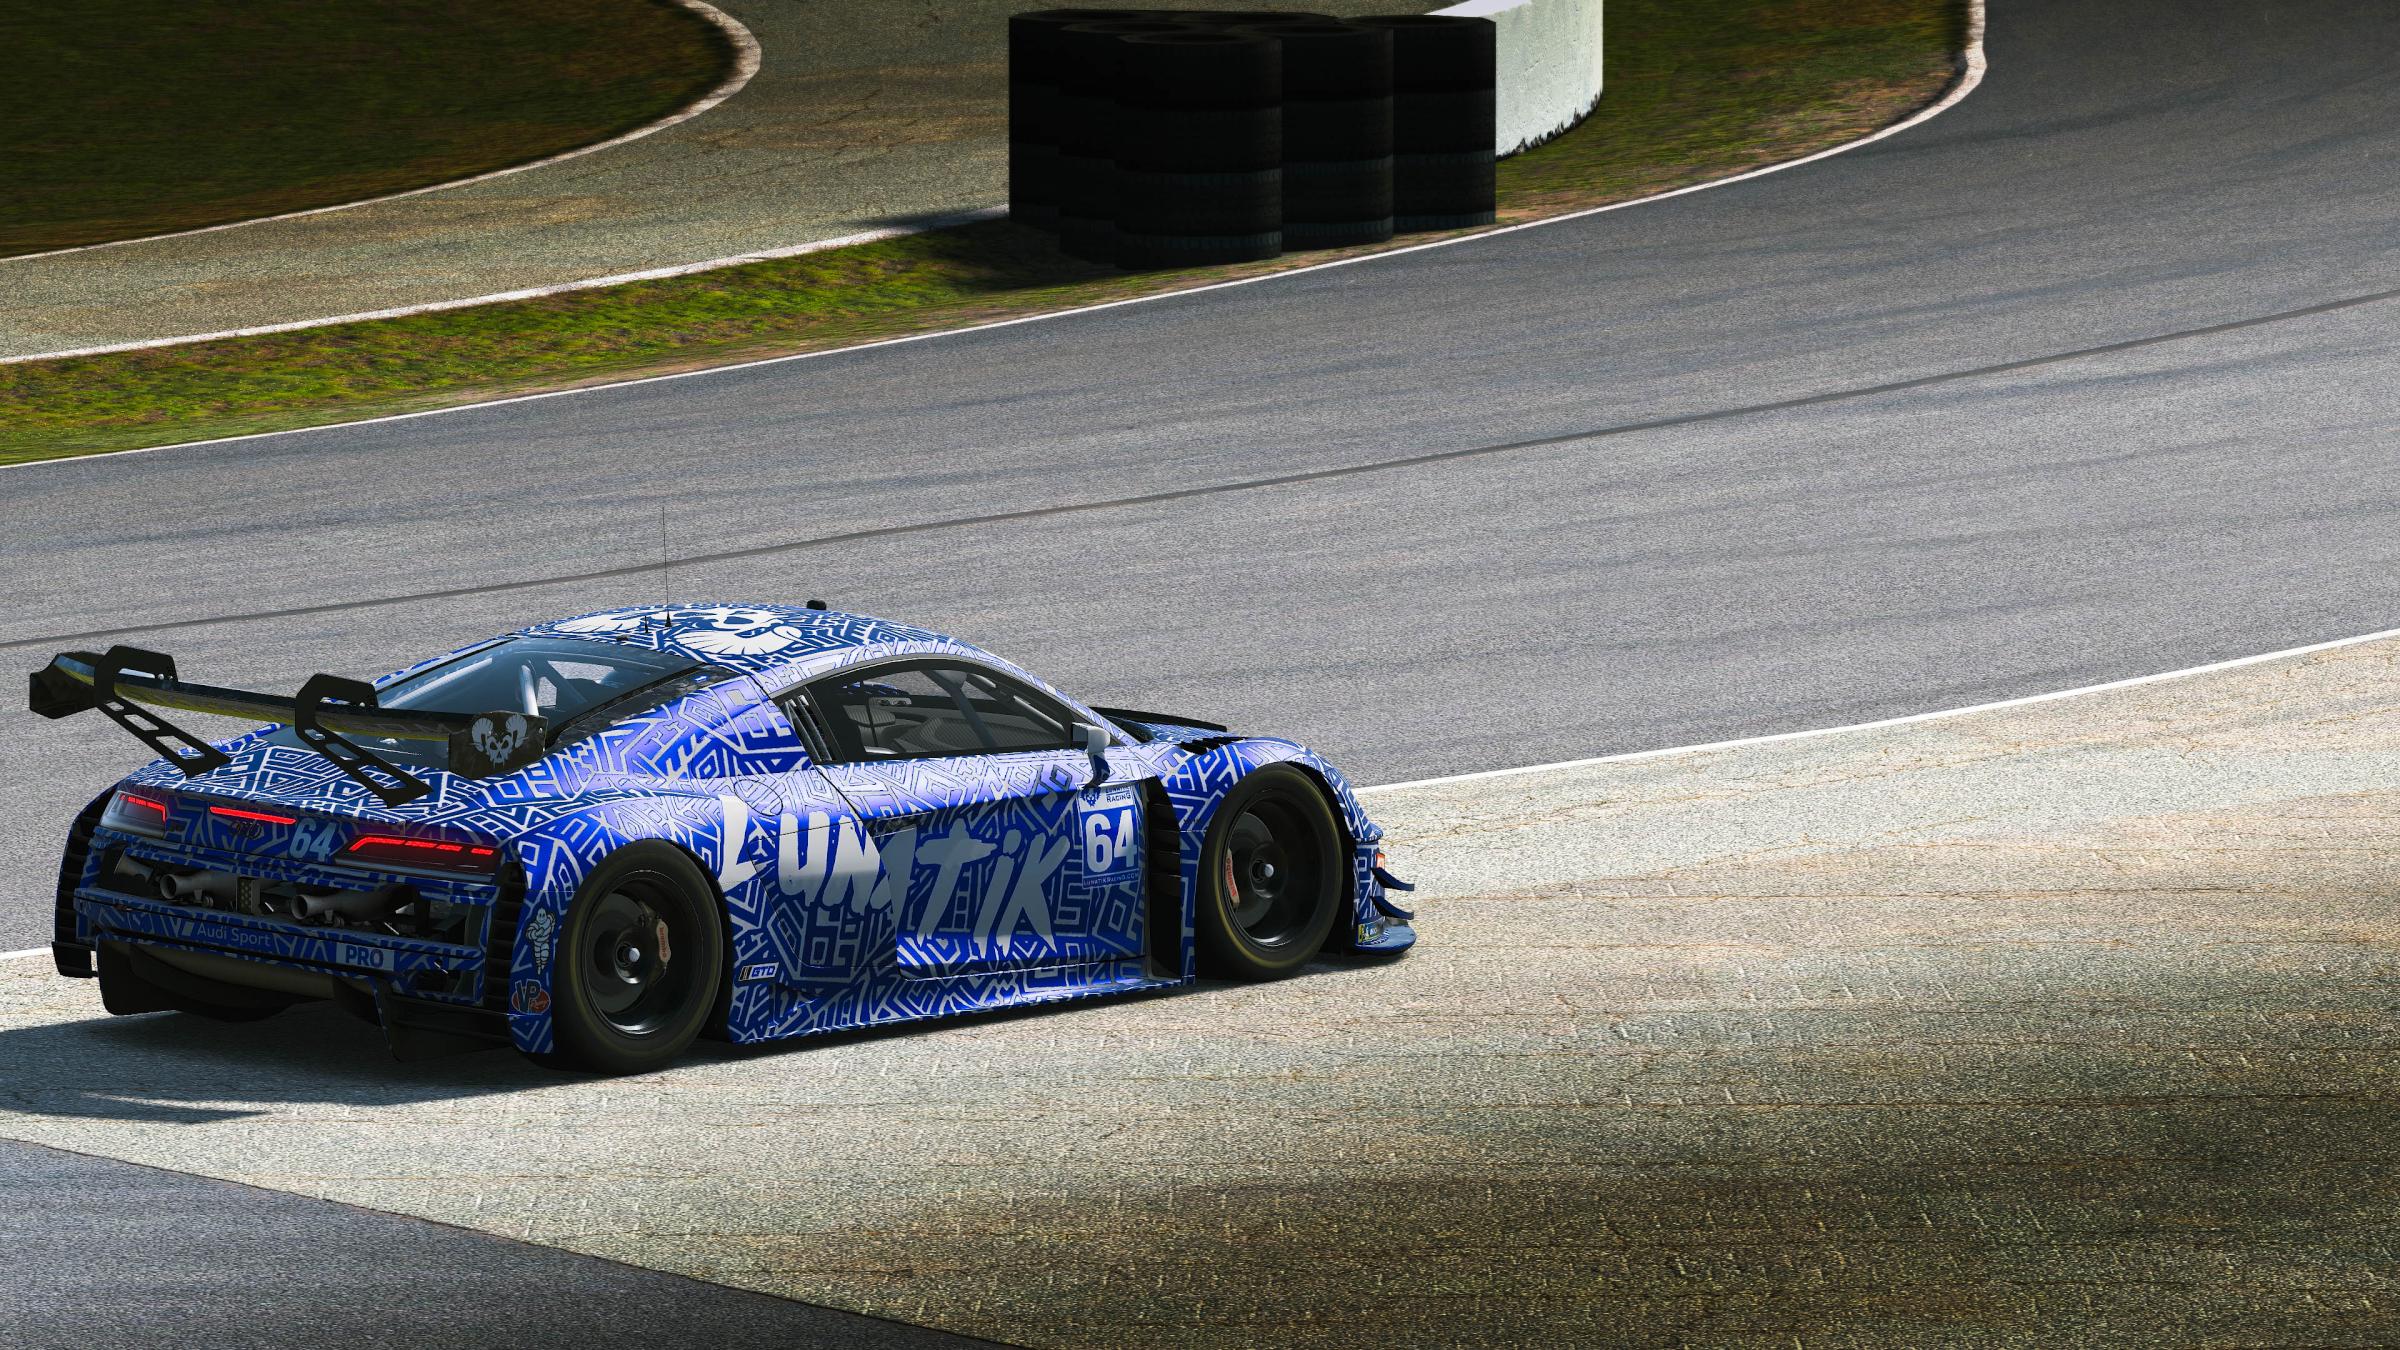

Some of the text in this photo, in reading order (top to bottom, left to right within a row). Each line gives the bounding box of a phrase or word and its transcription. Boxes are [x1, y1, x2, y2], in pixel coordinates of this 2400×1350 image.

[290, 818, 336, 862] 64
[1085, 809, 1138, 873] 64
[197, 925, 271, 947] Audi Sport
[345, 944, 384, 968] PRO
[752, 965, 776, 978] GTD
